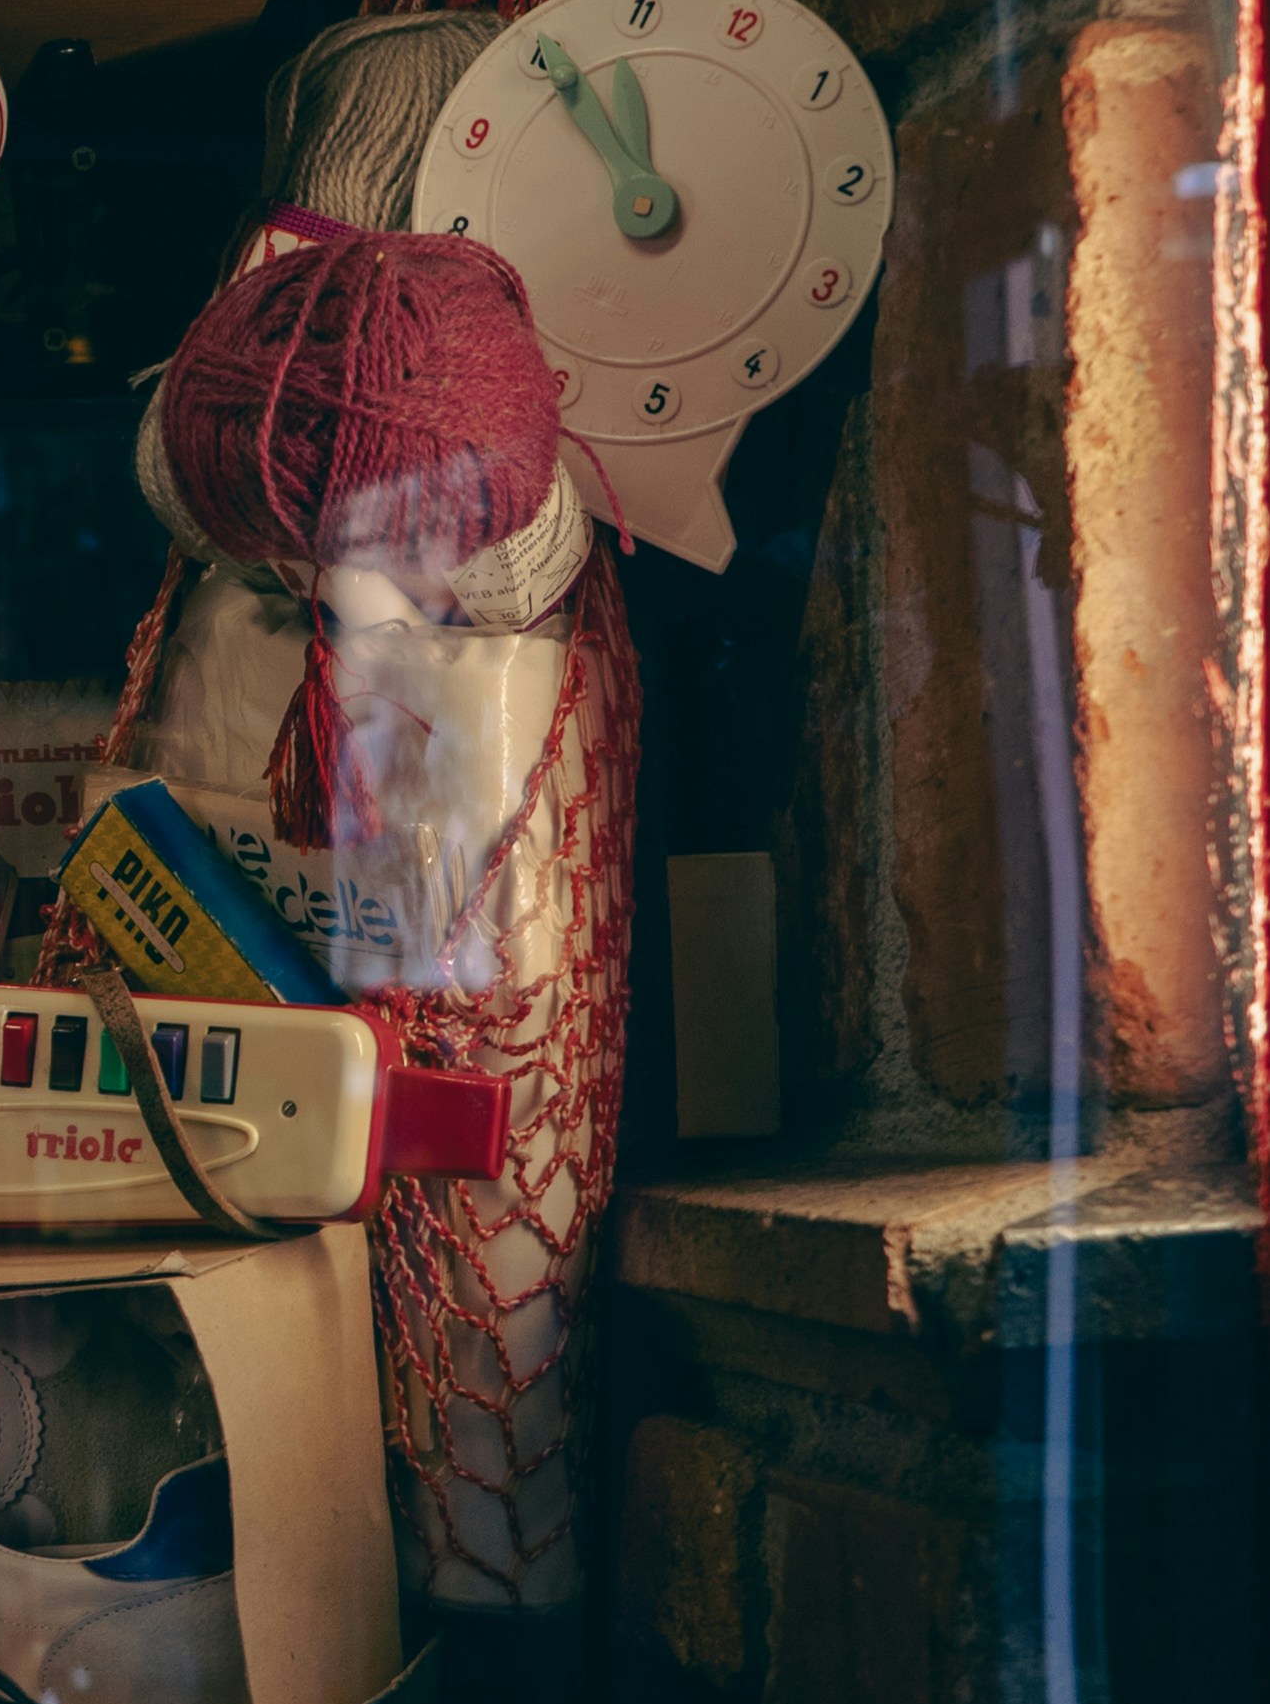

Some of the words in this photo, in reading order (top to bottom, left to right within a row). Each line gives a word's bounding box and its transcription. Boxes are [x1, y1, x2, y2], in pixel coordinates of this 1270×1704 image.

[726, 8, 759, 44] 12
[810, 70, 831, 102] 1
[465, 117, 491, 150] 9
[837, 164, 866, 198] 2
[811, 268, 841, 304] 3
[744, 348, 768, 380] 4
[643, 382, 671, 417] 5
[460, 589, 493, 600] VEB
[25, 1123, 146, 1165] triola
